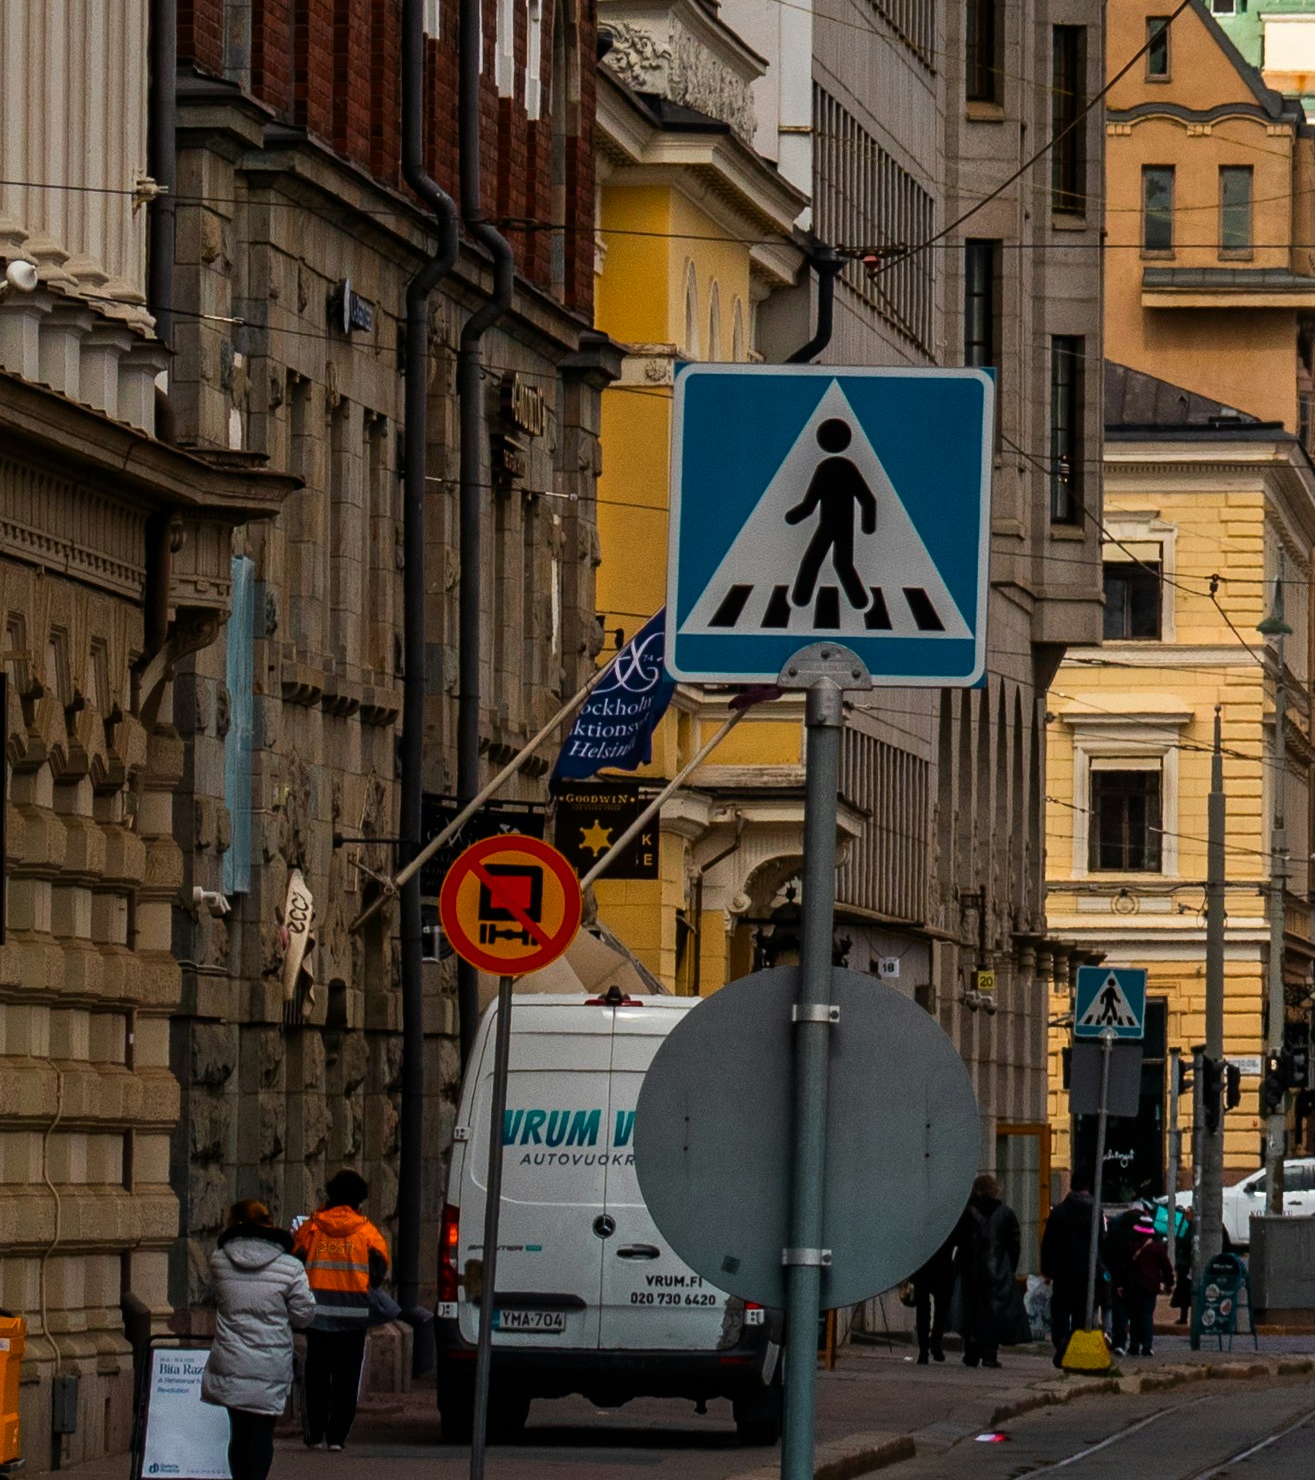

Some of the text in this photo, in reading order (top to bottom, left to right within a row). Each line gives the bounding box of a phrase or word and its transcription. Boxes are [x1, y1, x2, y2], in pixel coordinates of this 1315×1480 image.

[979, 975, 994, 987] 20
[658, 1292, 681, 1306] 730
[684, 1293, 716, 1307] 6420
